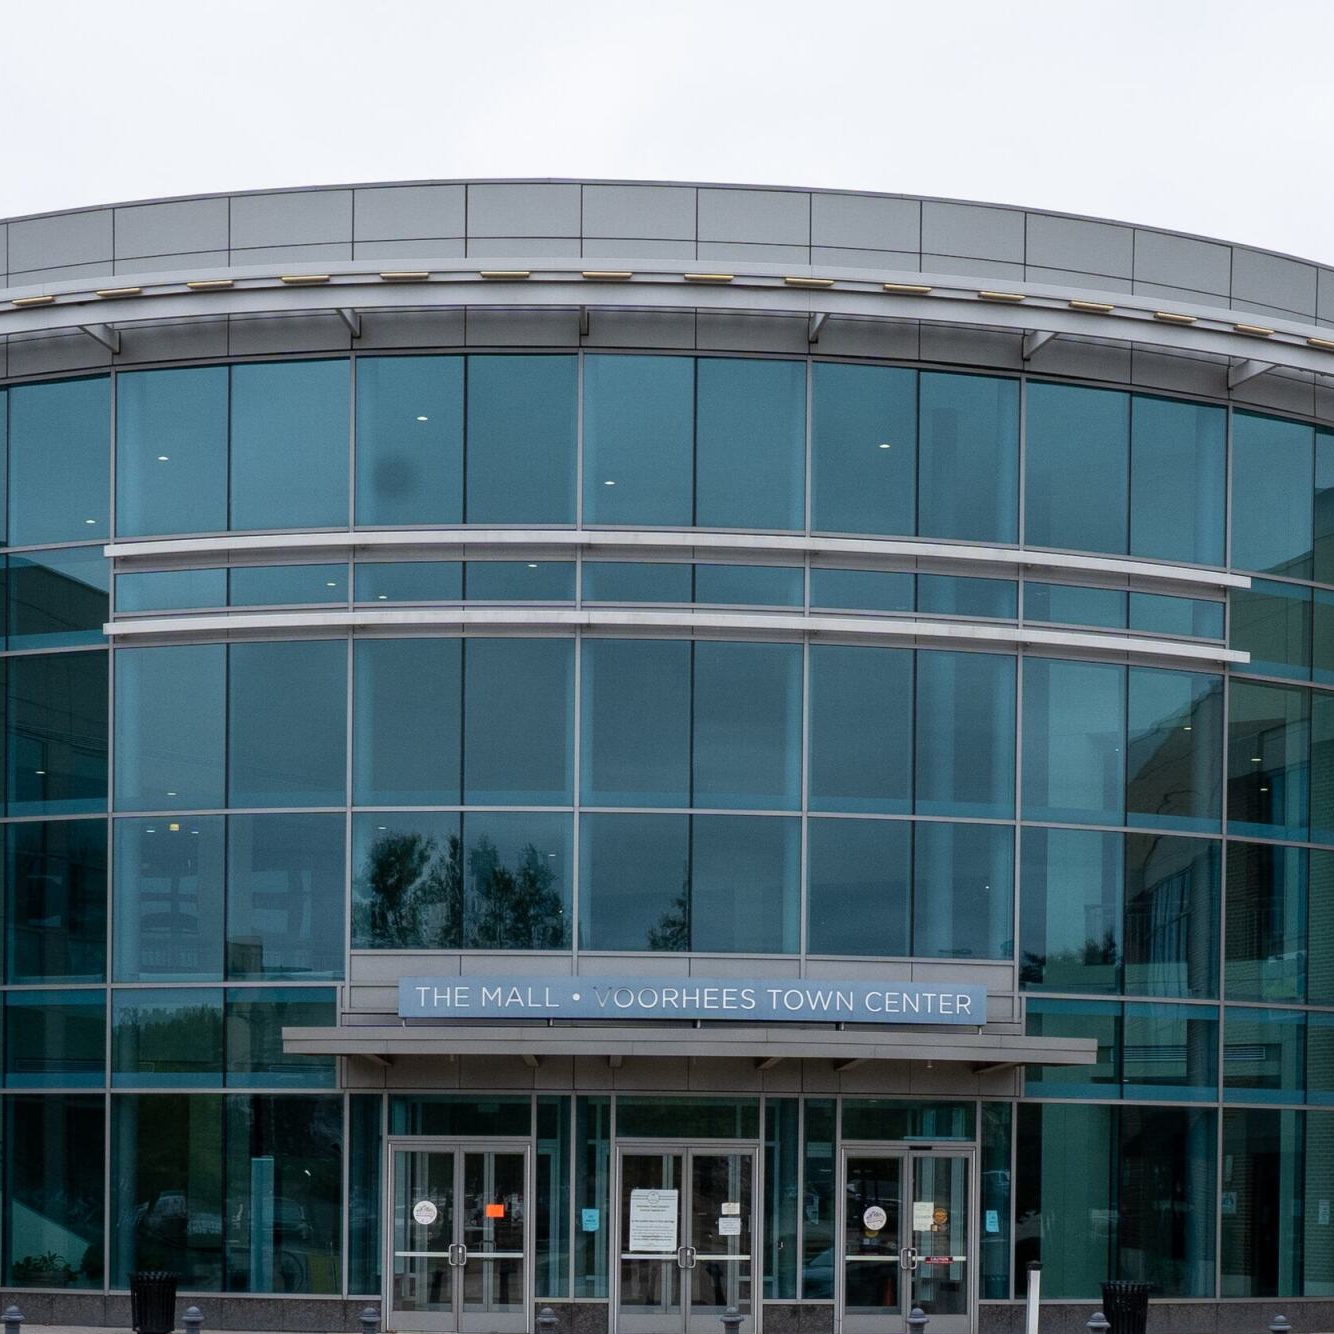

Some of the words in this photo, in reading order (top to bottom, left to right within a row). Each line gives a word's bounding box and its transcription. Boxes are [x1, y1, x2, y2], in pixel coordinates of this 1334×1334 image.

[415, 986, 470, 1008] THE
[482, 986, 560, 1008] MALL
[593, 986, 756, 1010] VOORHEES
[767, 989, 854, 1011] TOWN
[865, 991, 972, 1015] CENTER
